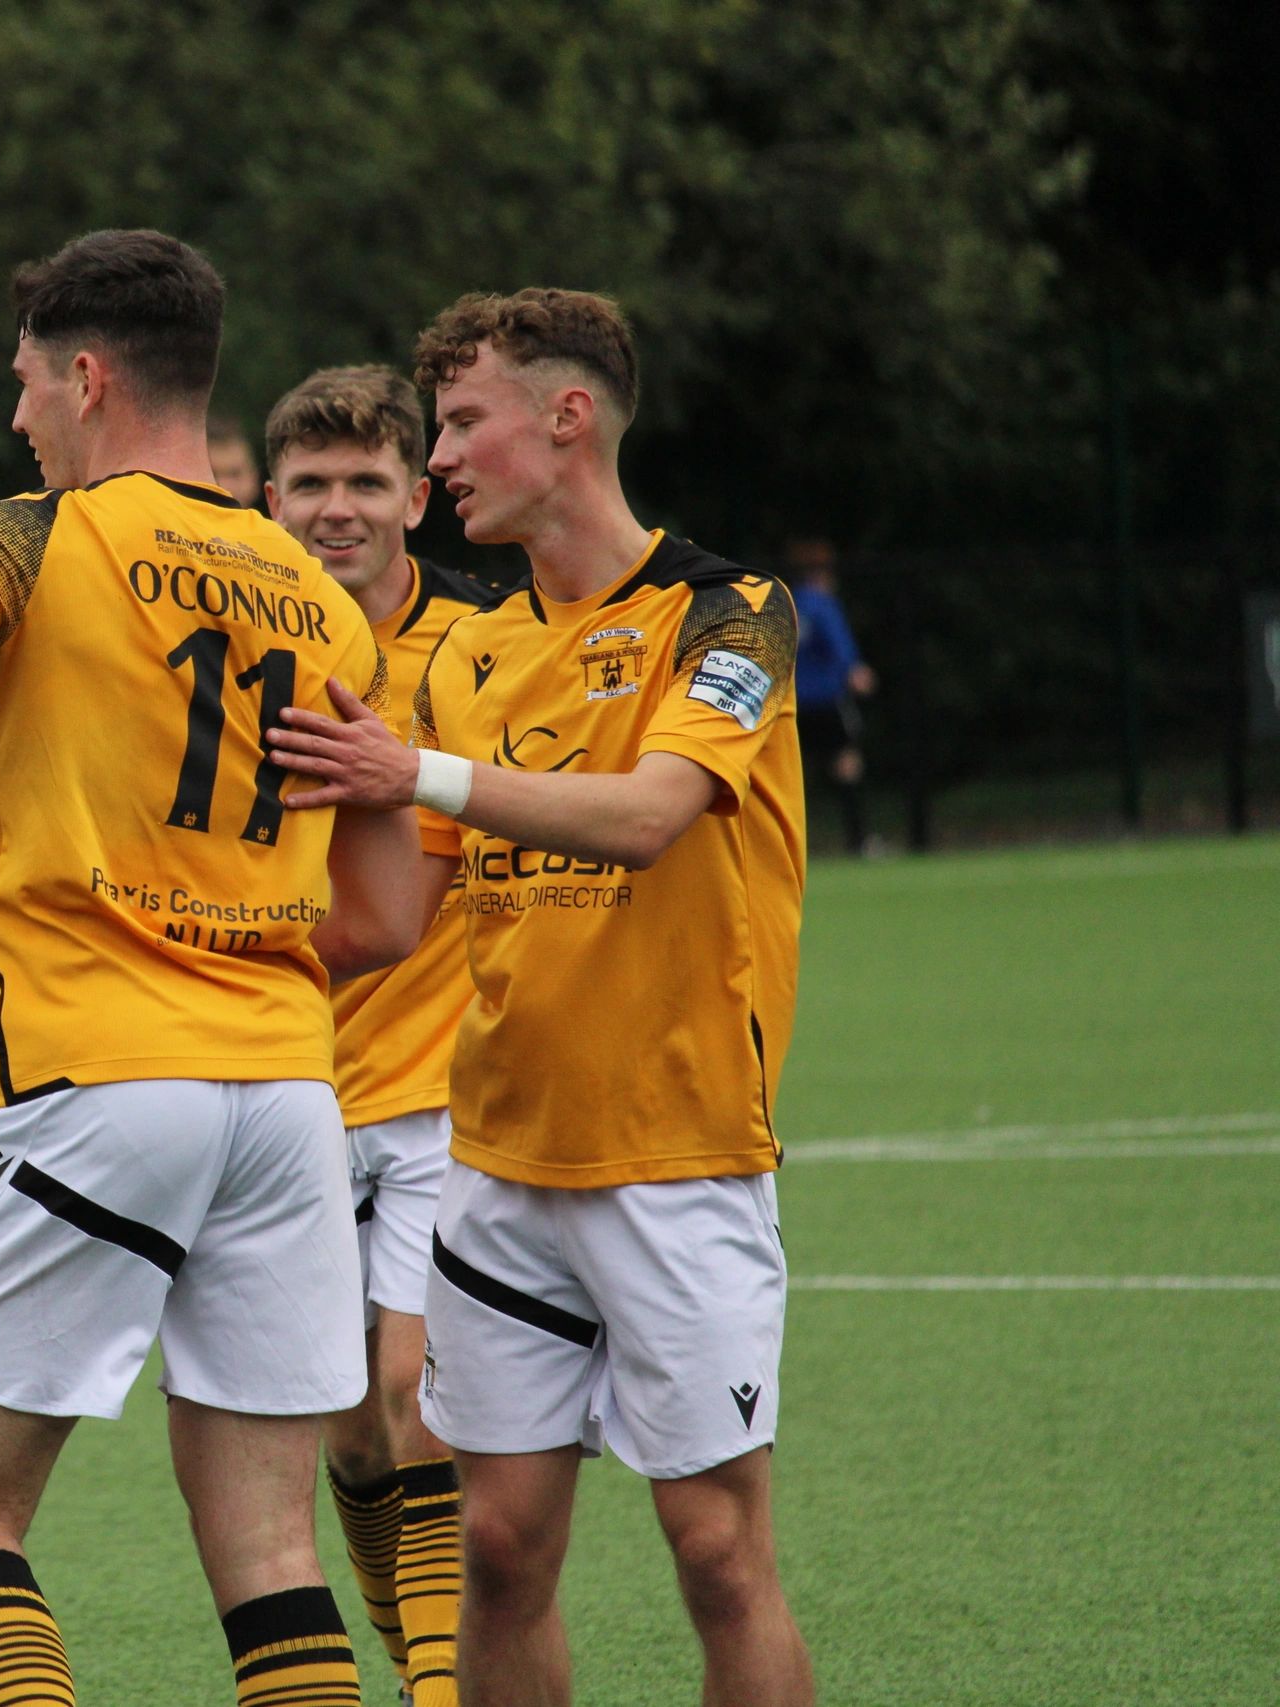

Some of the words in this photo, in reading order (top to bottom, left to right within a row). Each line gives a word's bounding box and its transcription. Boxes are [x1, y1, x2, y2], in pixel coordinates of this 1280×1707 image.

[155, 529, 204, 555] READY
[205, 543, 300, 583] CONSTRUCTION
[129, 560, 331, 645] O'CONNOR
[166, 626, 296, 847] 11
[528, 885, 632, 909] DIRECTOR
